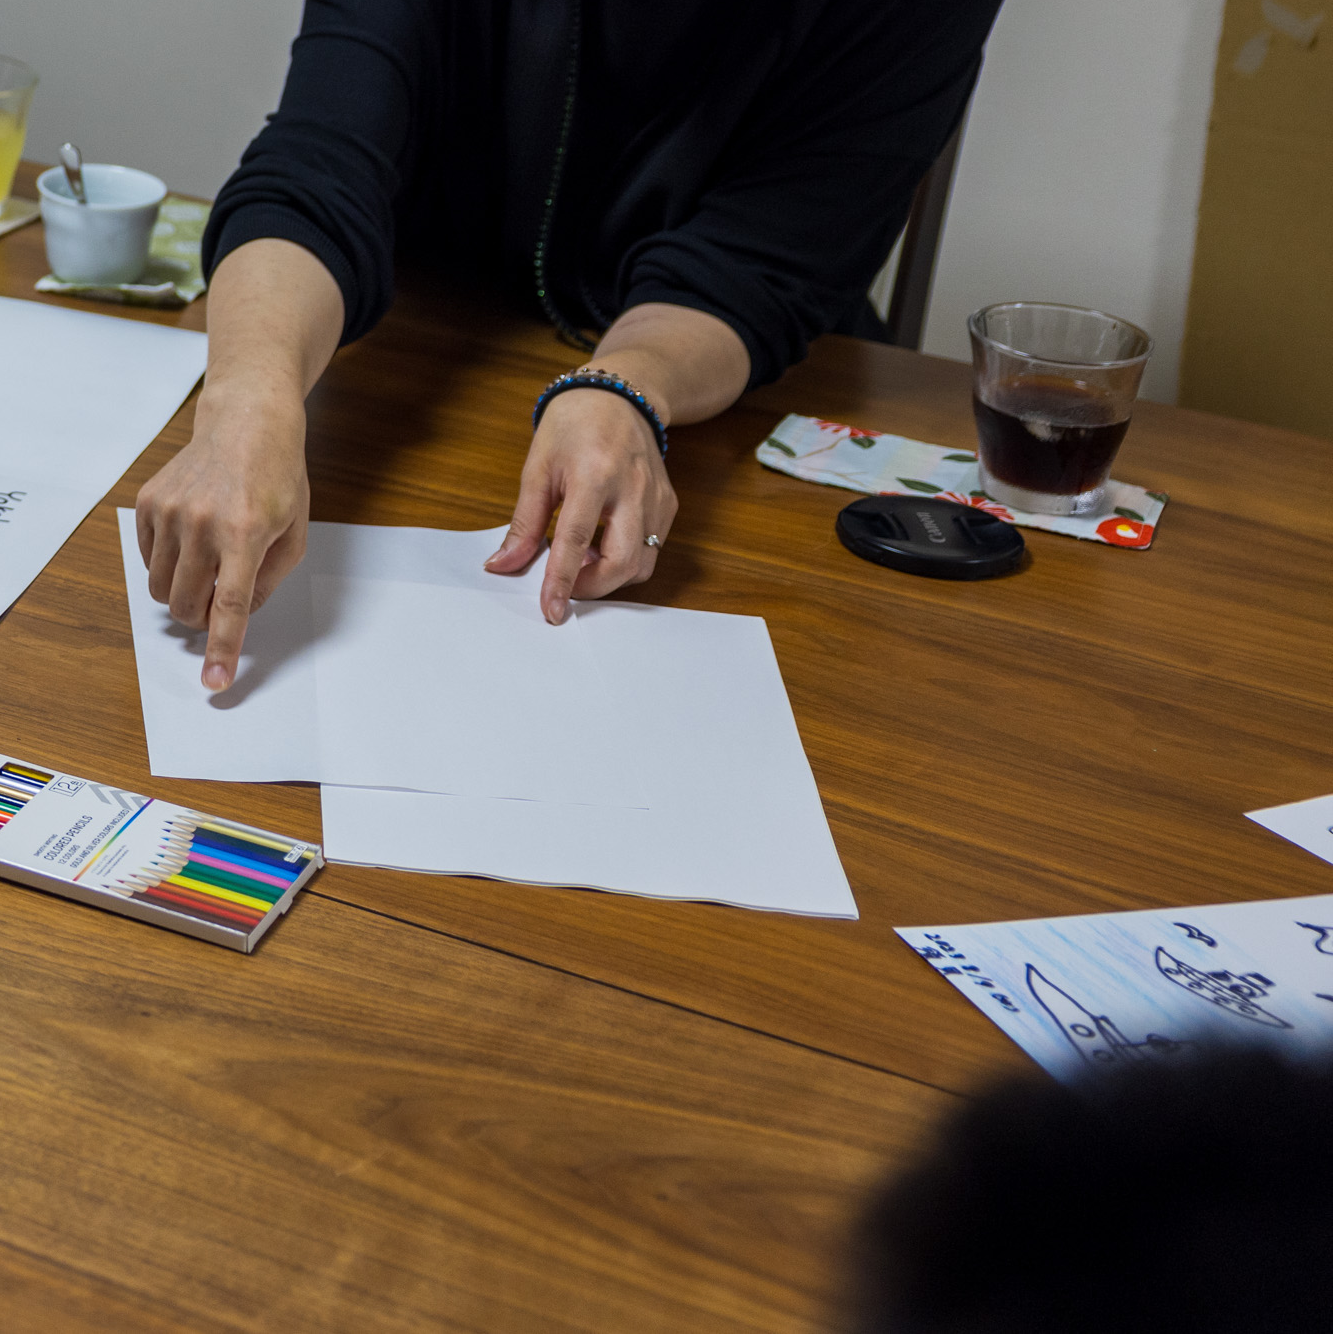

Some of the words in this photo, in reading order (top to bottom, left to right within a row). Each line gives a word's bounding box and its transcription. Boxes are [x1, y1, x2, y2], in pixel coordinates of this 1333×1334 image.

[43, 835, 73, 861] COLORED
[65, 814, 93, 838] PENCILS
[63, 844, 81, 860] COLORS
